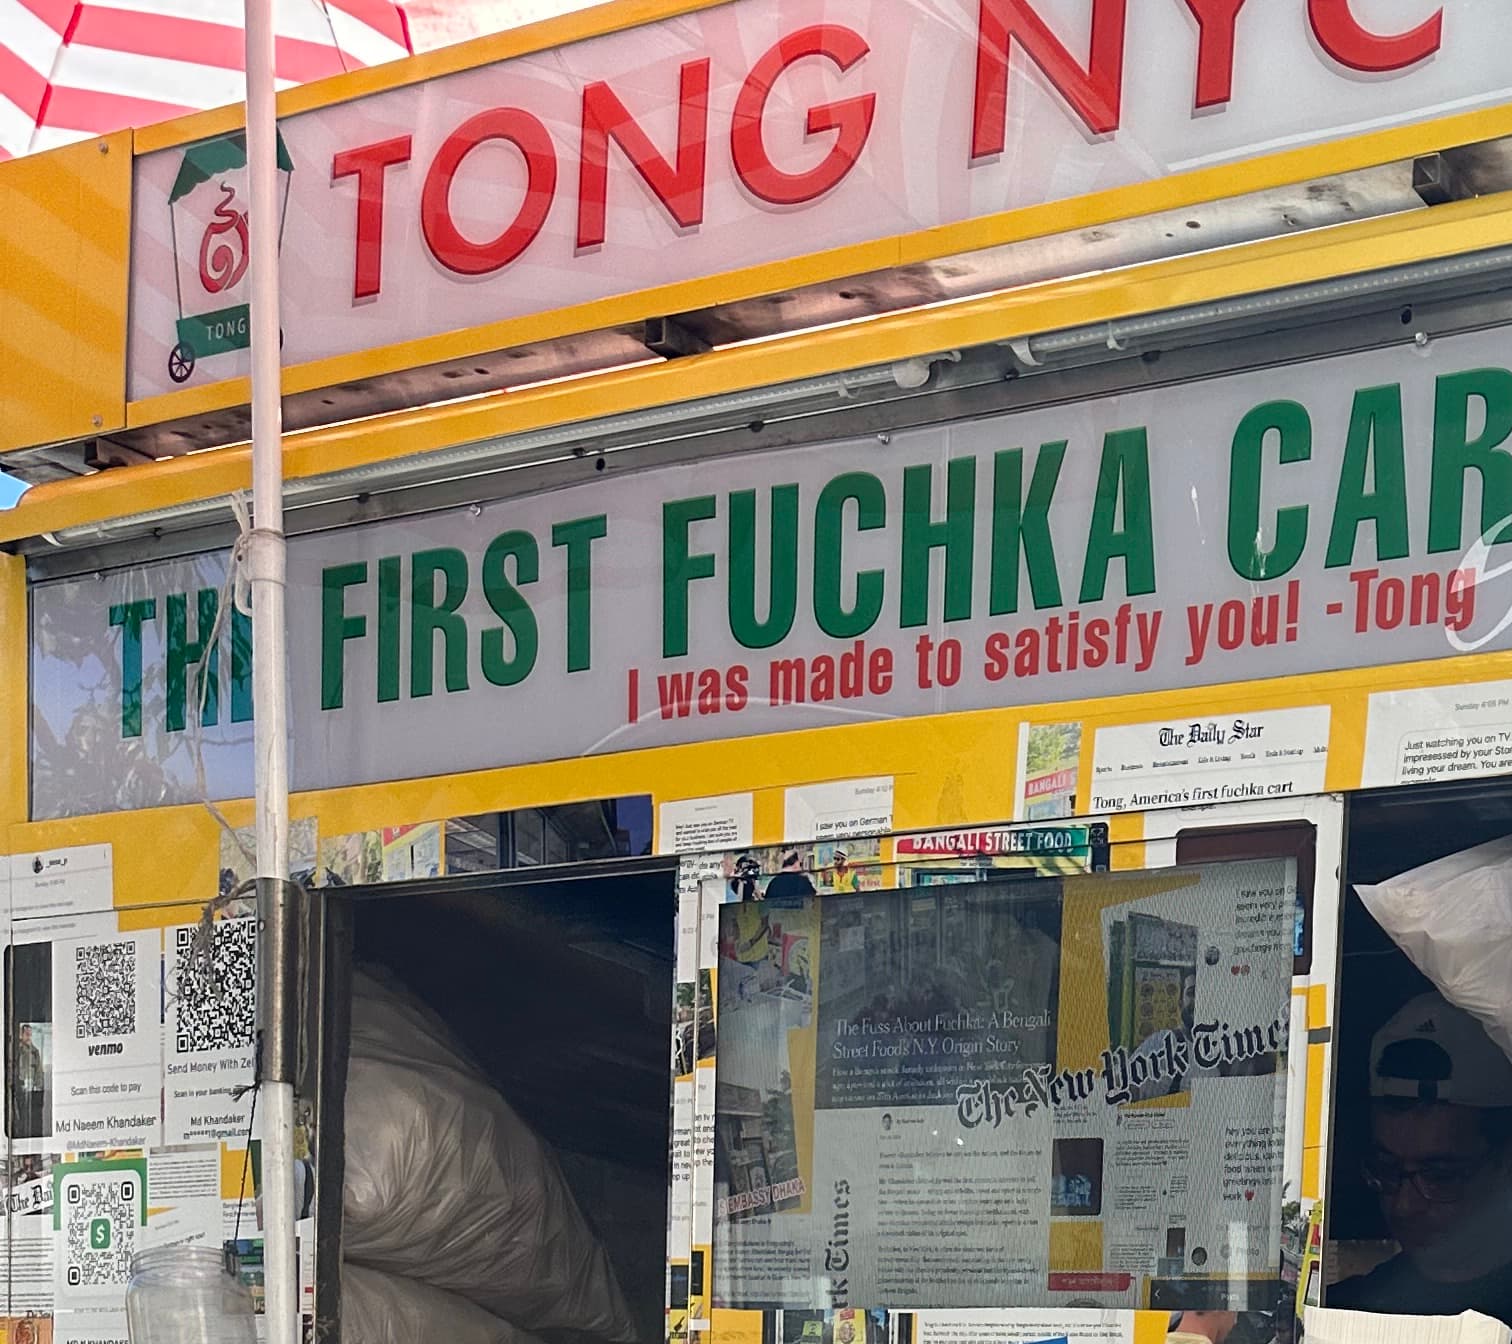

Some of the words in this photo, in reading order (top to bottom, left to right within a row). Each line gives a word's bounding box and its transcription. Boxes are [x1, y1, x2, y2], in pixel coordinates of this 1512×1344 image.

[332, 23, 877, 304] TONG
[205, 317, 246, 342] TONG
[321, 514, 608, 712] FIRST
[662, 427, 1158, 659] FUCHKA
[627, 668, 640, 723] I
[657, 664, 748, 720] was
[769, 638, 895, 707] made
[916, 640, 962, 690] to
[983, 605, 1162, 682] satisfy
[1184, 580, 1299, 666] you!
[1326, 563, 1477, 633] -Tong
[1159, 726, 1183, 747] The
[1186, 723, 1226, 748] Daily
[1228, 719, 1264, 744] Star
[1093, 795, 1128, 811] Tong,
[1130, 788, 1190, 807] America's
[1192, 786, 1218, 801] first
[1221, 782, 1264, 800] fuchka
[1267, 780, 1293, 794] cart
[913, 833, 980, 853] BANGALI
[984, 829, 1034, 853] STREET
[1036, 831, 1073, 851] FOOD
[837, 1019, 859, 1036] The
[862, 1018, 890, 1035] Fuss
[893, 1017, 931, 1033] About
[988, 1013, 999, 1029] A
[1003, 1009, 1050, 1030] Bengali
[88, 1041, 123, 1057] venmo
[168, 1063, 188, 1074] Send
[190, 1061, 217, 1074] Money
[220, 1060, 238, 1070] With
[957, 1080, 1018, 1129] The
[1023, 1064, 1096, 1118] New
[1101, 1030, 1192, 1105] York
[56, 1121, 70, 1132] Md
[73, 1119, 104, 1131] Naeem
[107, 1115, 157, 1128] Khandaker
